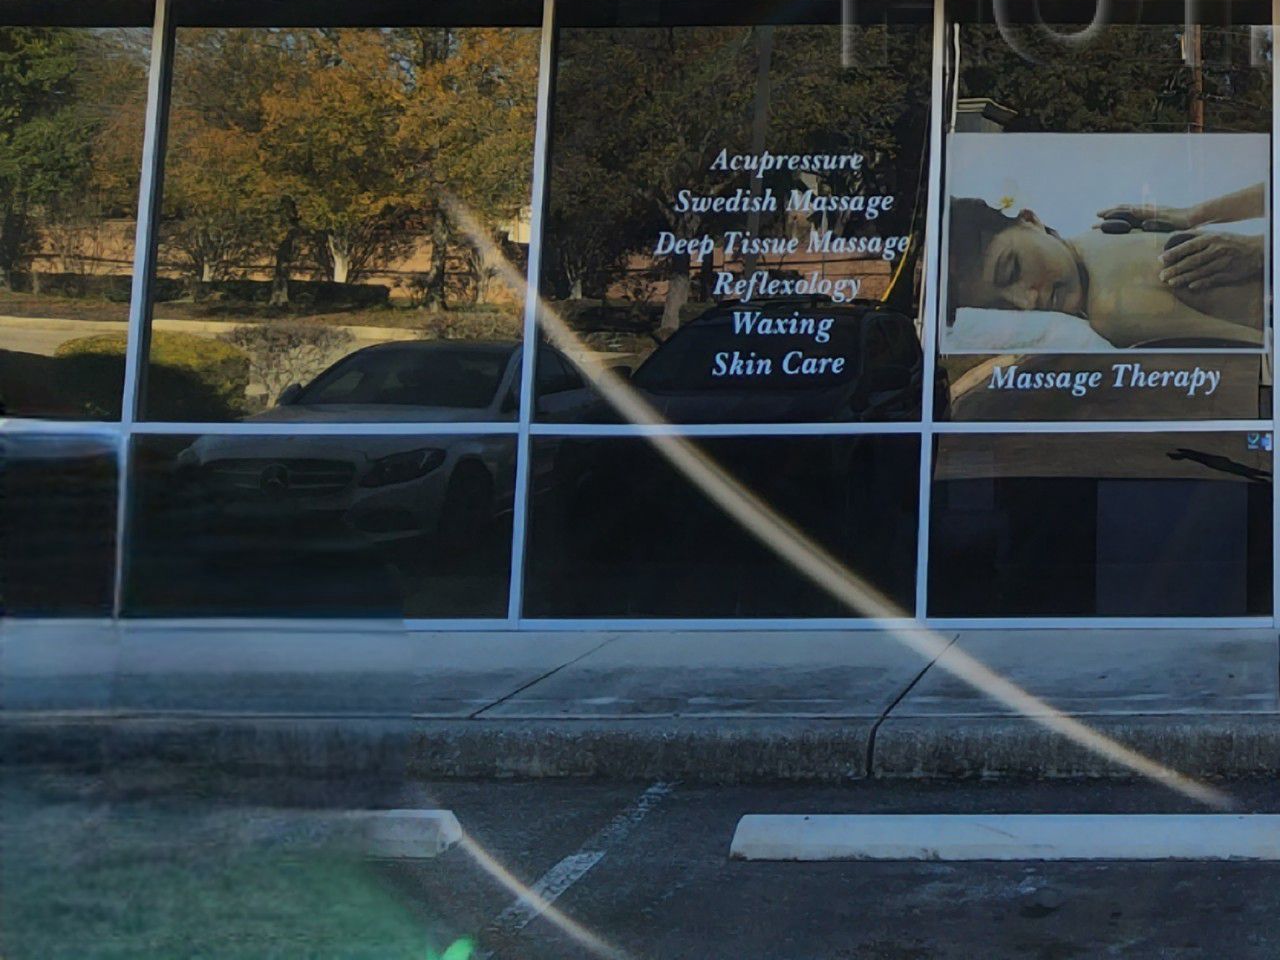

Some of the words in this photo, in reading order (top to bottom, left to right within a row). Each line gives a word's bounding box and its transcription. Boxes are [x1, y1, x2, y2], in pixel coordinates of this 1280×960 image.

[710, 148, 863, 178] Acupressure
[674, 189, 777, 213] Swedish
[786, 189, 894, 220] Massage
[654, 231, 714, 262] Deep
[723, 231, 798, 254] Tissue
[806, 231, 910, 260] Massage
[713, 271, 861, 302] Reflexology
[732, 311, 834, 343] Waxing
[711, 351, 773, 376] Skin
[782, 351, 846, 374] Care
[988, 365, 1103, 396] Massage
[1111, 363, 1220, 396] Therapy
